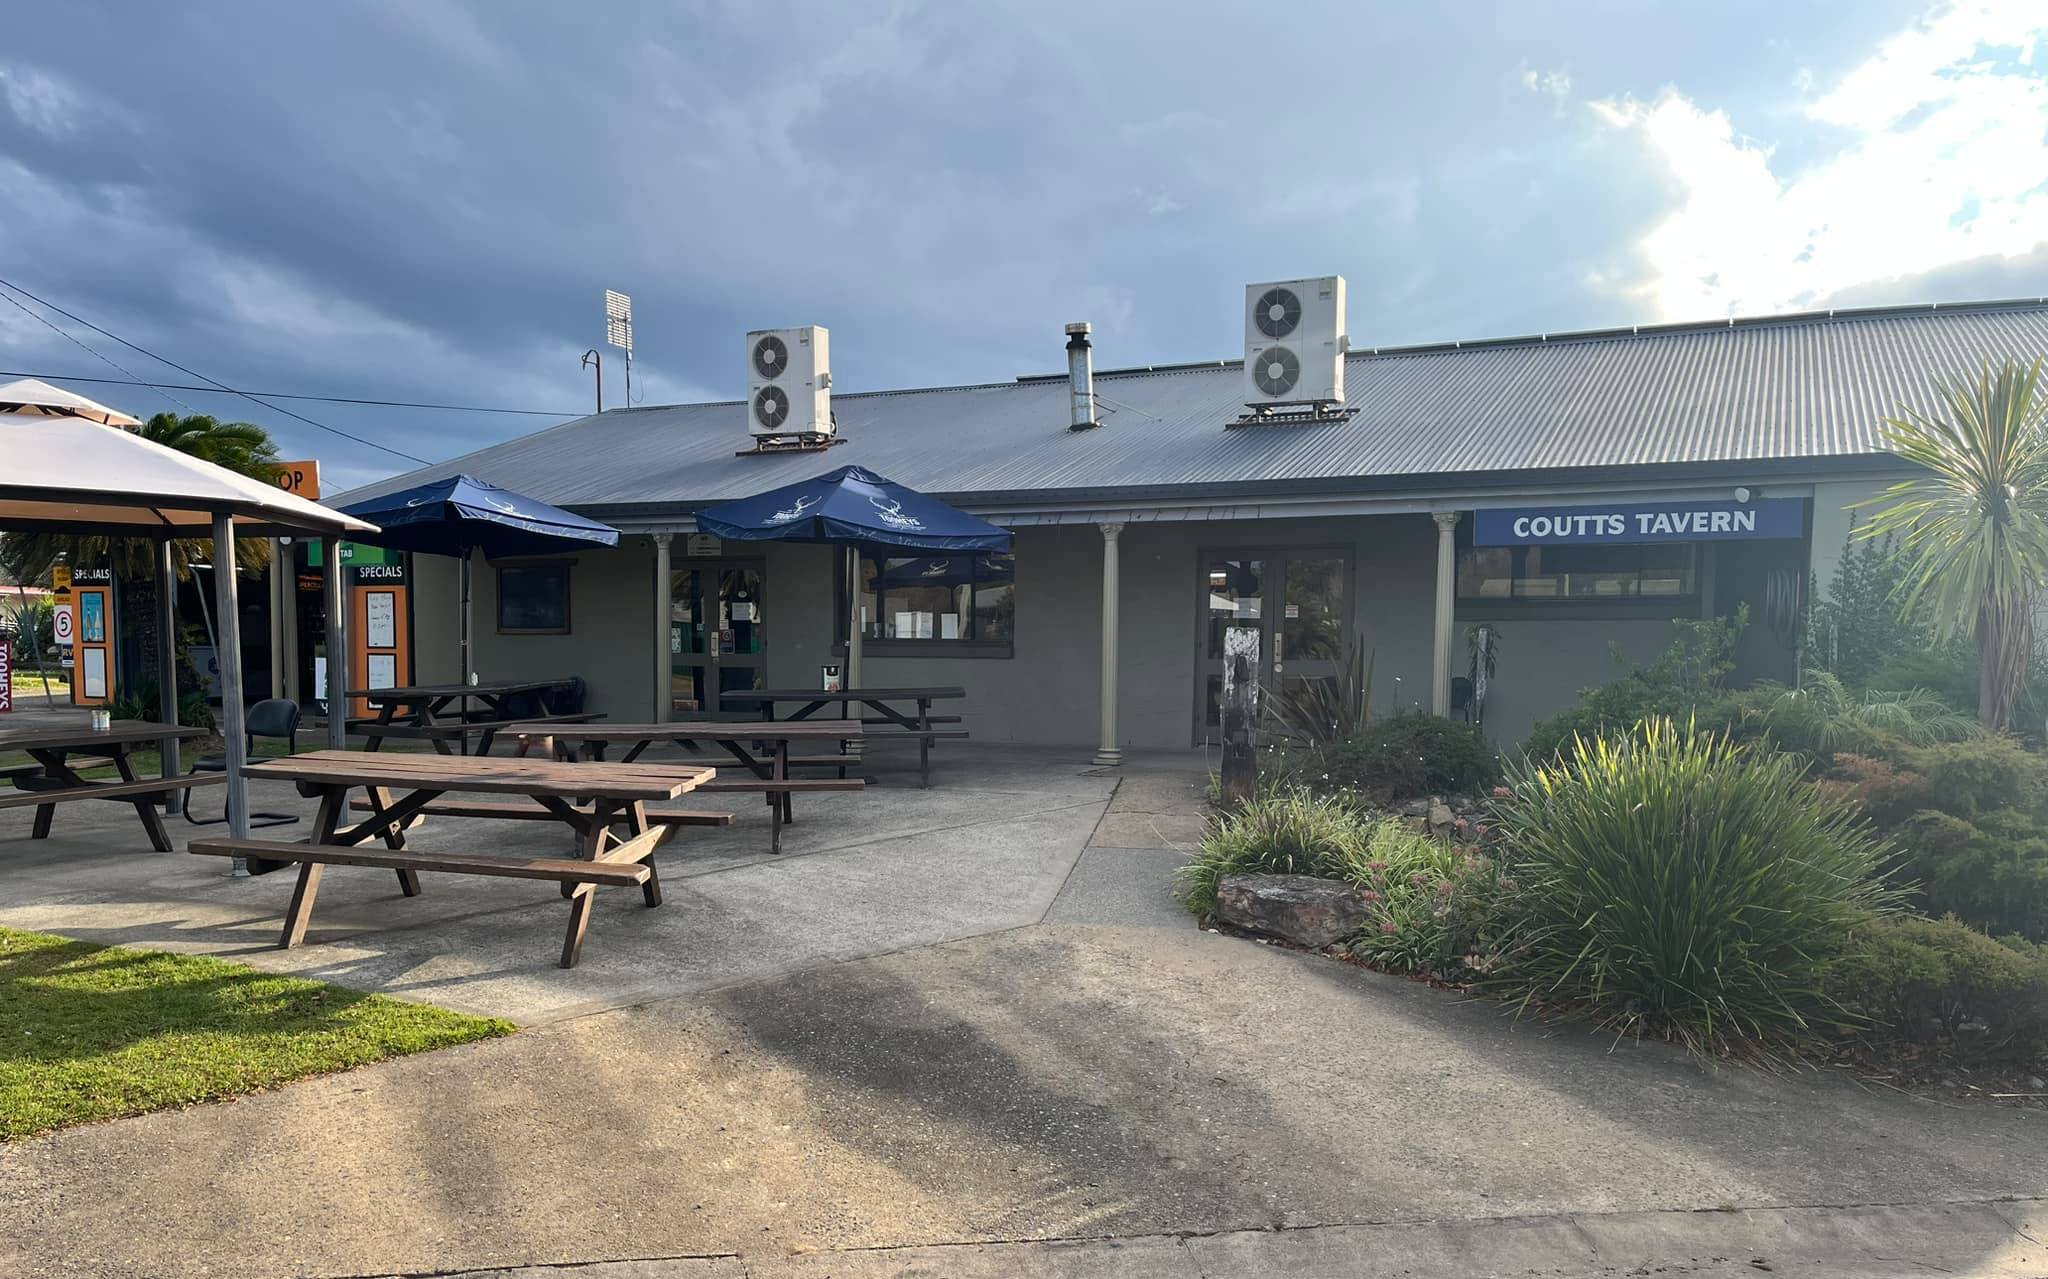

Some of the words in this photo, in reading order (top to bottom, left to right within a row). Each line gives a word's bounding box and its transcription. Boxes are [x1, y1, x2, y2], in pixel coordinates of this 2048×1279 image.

[278, 470, 304, 491] OP
[1513, 514, 1625, 537] COUTTS
[1635, 510, 1756, 535] TAVERN
[340, 549, 353, 558] TAB
[74, 568, 110, 580] SPECIALS
[360, 566, 402, 578] SPECIALS
[60, 617, 68, 632] 5
[0, 643, 9, 710] TOOHEYS
